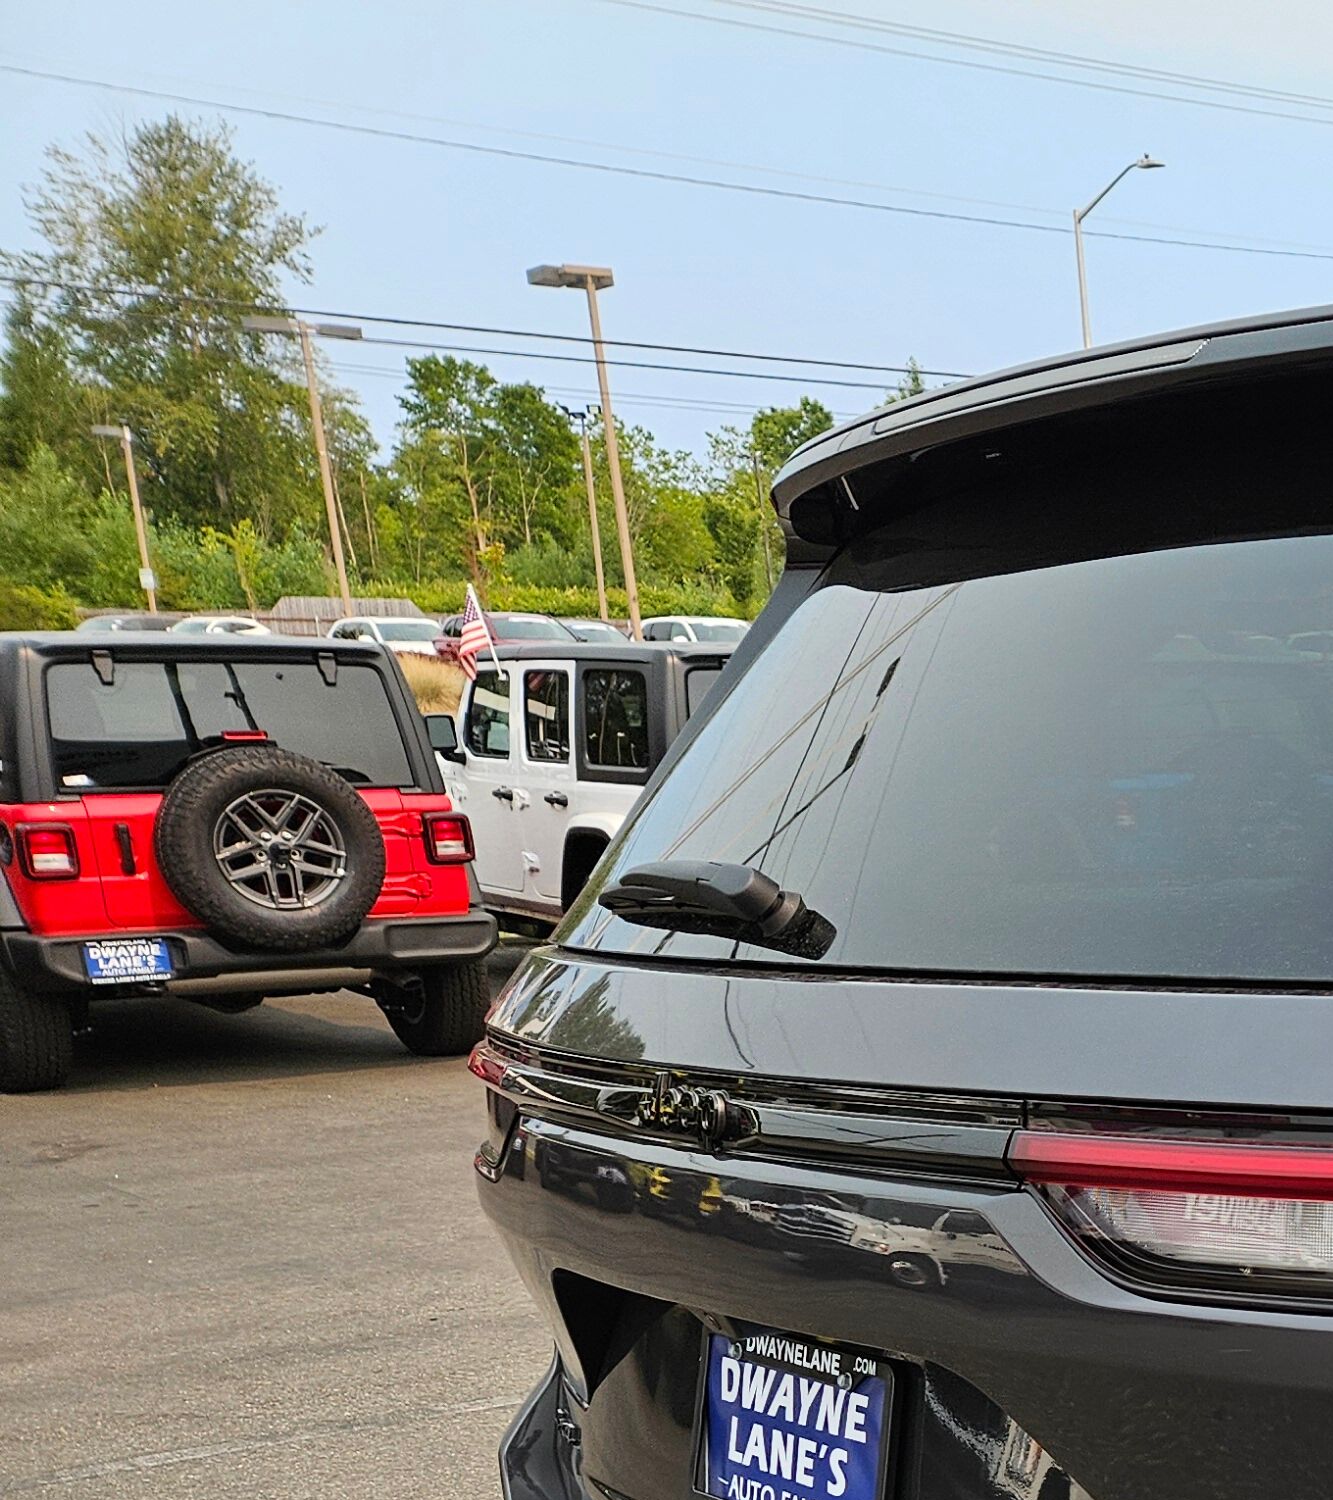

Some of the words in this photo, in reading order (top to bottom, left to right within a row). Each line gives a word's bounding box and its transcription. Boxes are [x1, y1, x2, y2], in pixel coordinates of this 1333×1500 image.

[88, 943, 160, 959] DWAYNE
[98, 955, 156, 969] LANE'S
[746, 1336, 841, 1376] DWAYNELANE
[720, 1356, 869, 1444] DWAYNE
[727, 1415, 848, 1497] LANE'S
